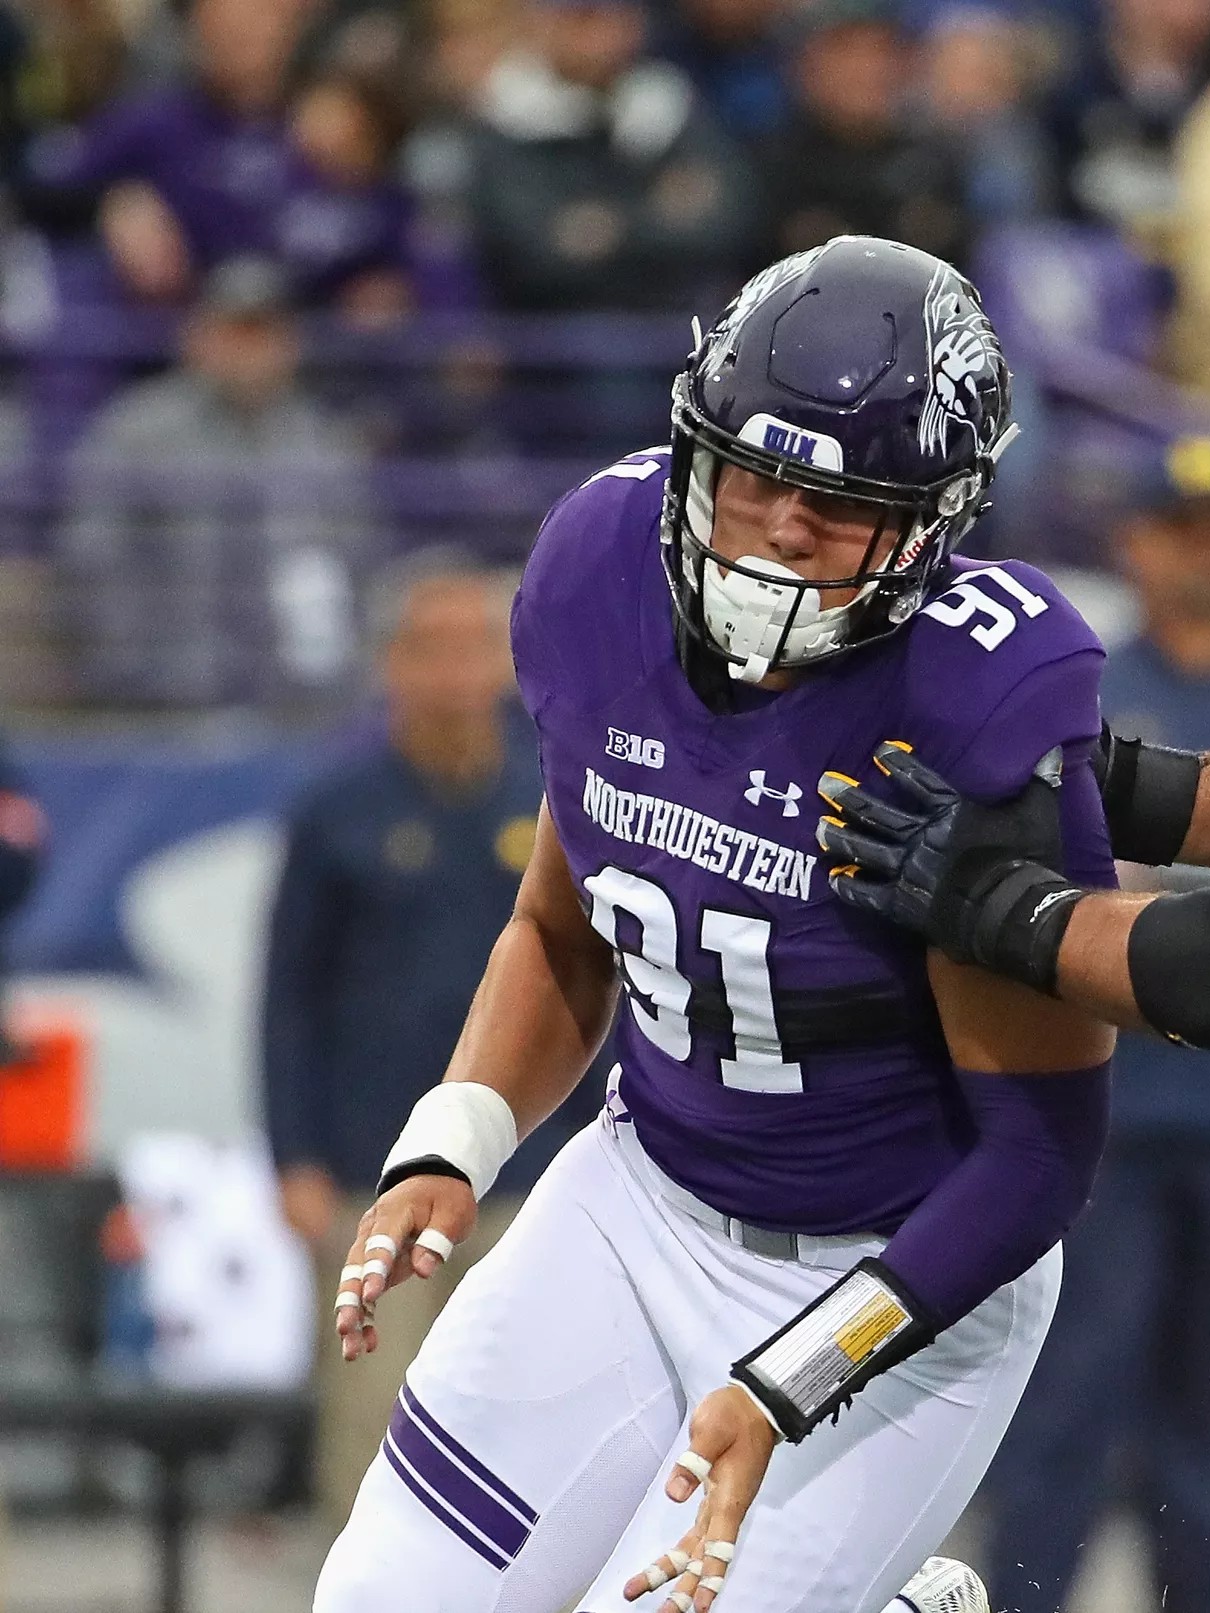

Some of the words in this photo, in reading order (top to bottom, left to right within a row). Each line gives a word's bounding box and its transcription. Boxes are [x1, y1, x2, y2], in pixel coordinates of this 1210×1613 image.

[918, 566, 1050, 652] 91
[582, 766, 817, 901] NORTHWESTERN
[583, 865, 804, 1094] 91
